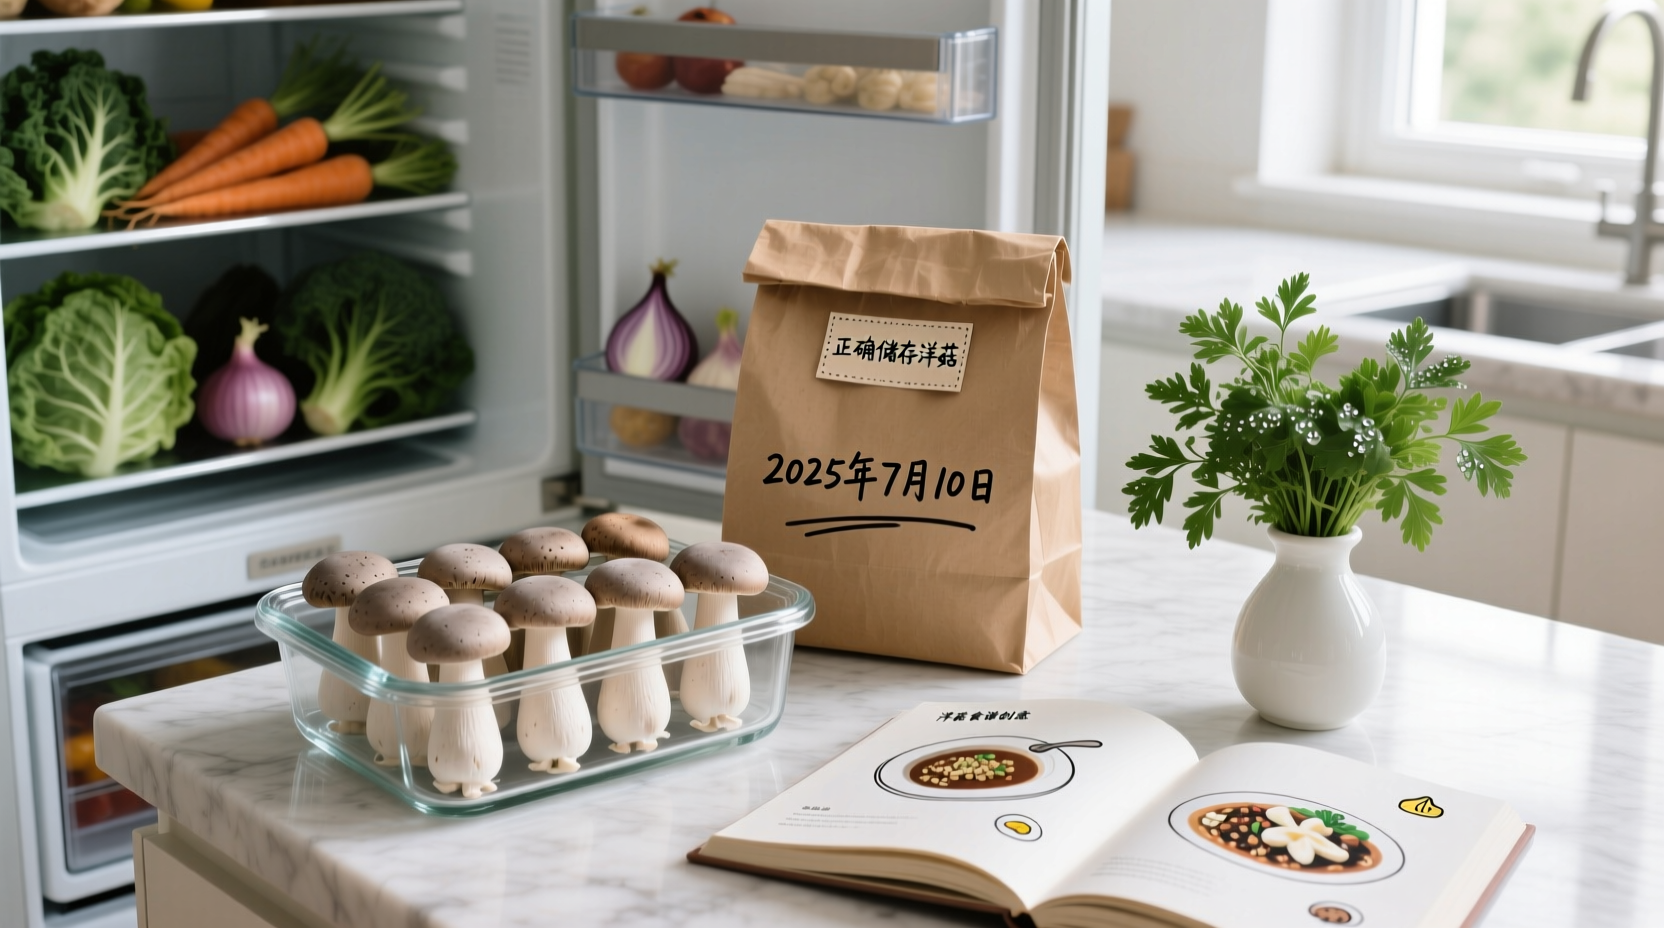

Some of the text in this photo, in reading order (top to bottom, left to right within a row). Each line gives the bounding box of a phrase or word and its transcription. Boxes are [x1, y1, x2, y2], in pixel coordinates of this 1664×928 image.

[832, 336, 959, 368] 正确储存洋菇
[763, 451, 993, 504] 2025年7月10日
